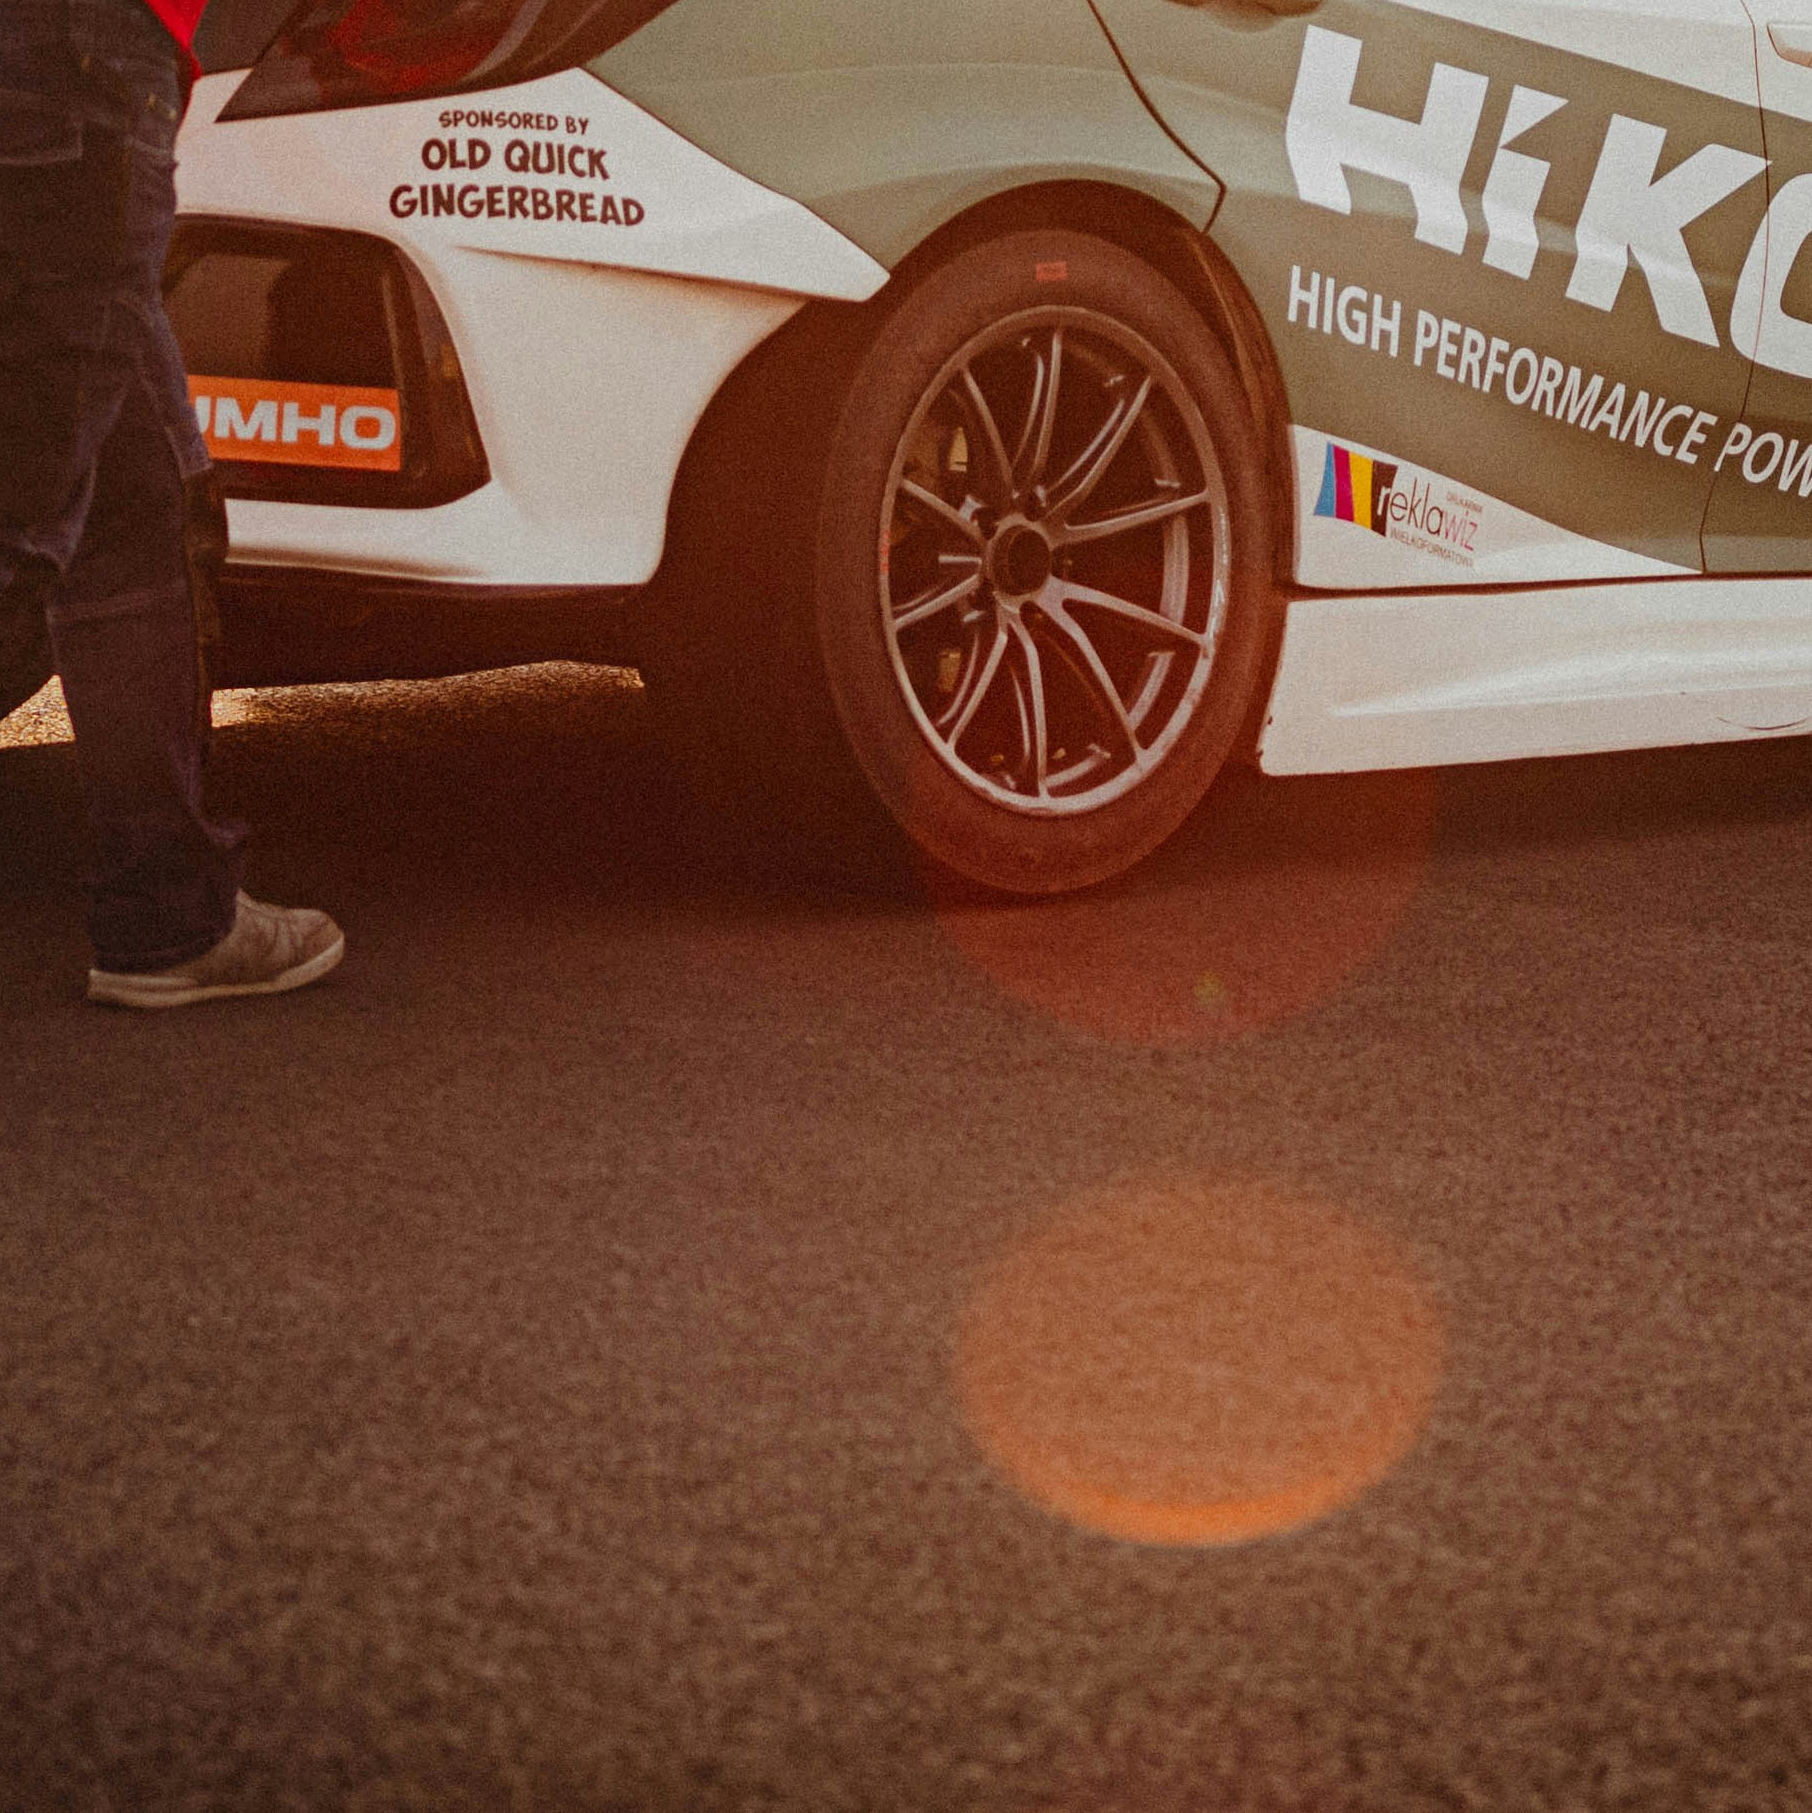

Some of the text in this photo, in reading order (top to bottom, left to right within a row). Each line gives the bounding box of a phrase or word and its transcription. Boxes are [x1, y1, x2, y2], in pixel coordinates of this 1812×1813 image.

[439, 109, 589, 135] SPONSORED BY
[421, 138, 610, 181] OLD QUICK
[389, 184, 645, 227] GINGERBREAD
[1287, 265, 1402, 358] HIGH
[1413, 309, 1716, 465] PERFORMANCE
